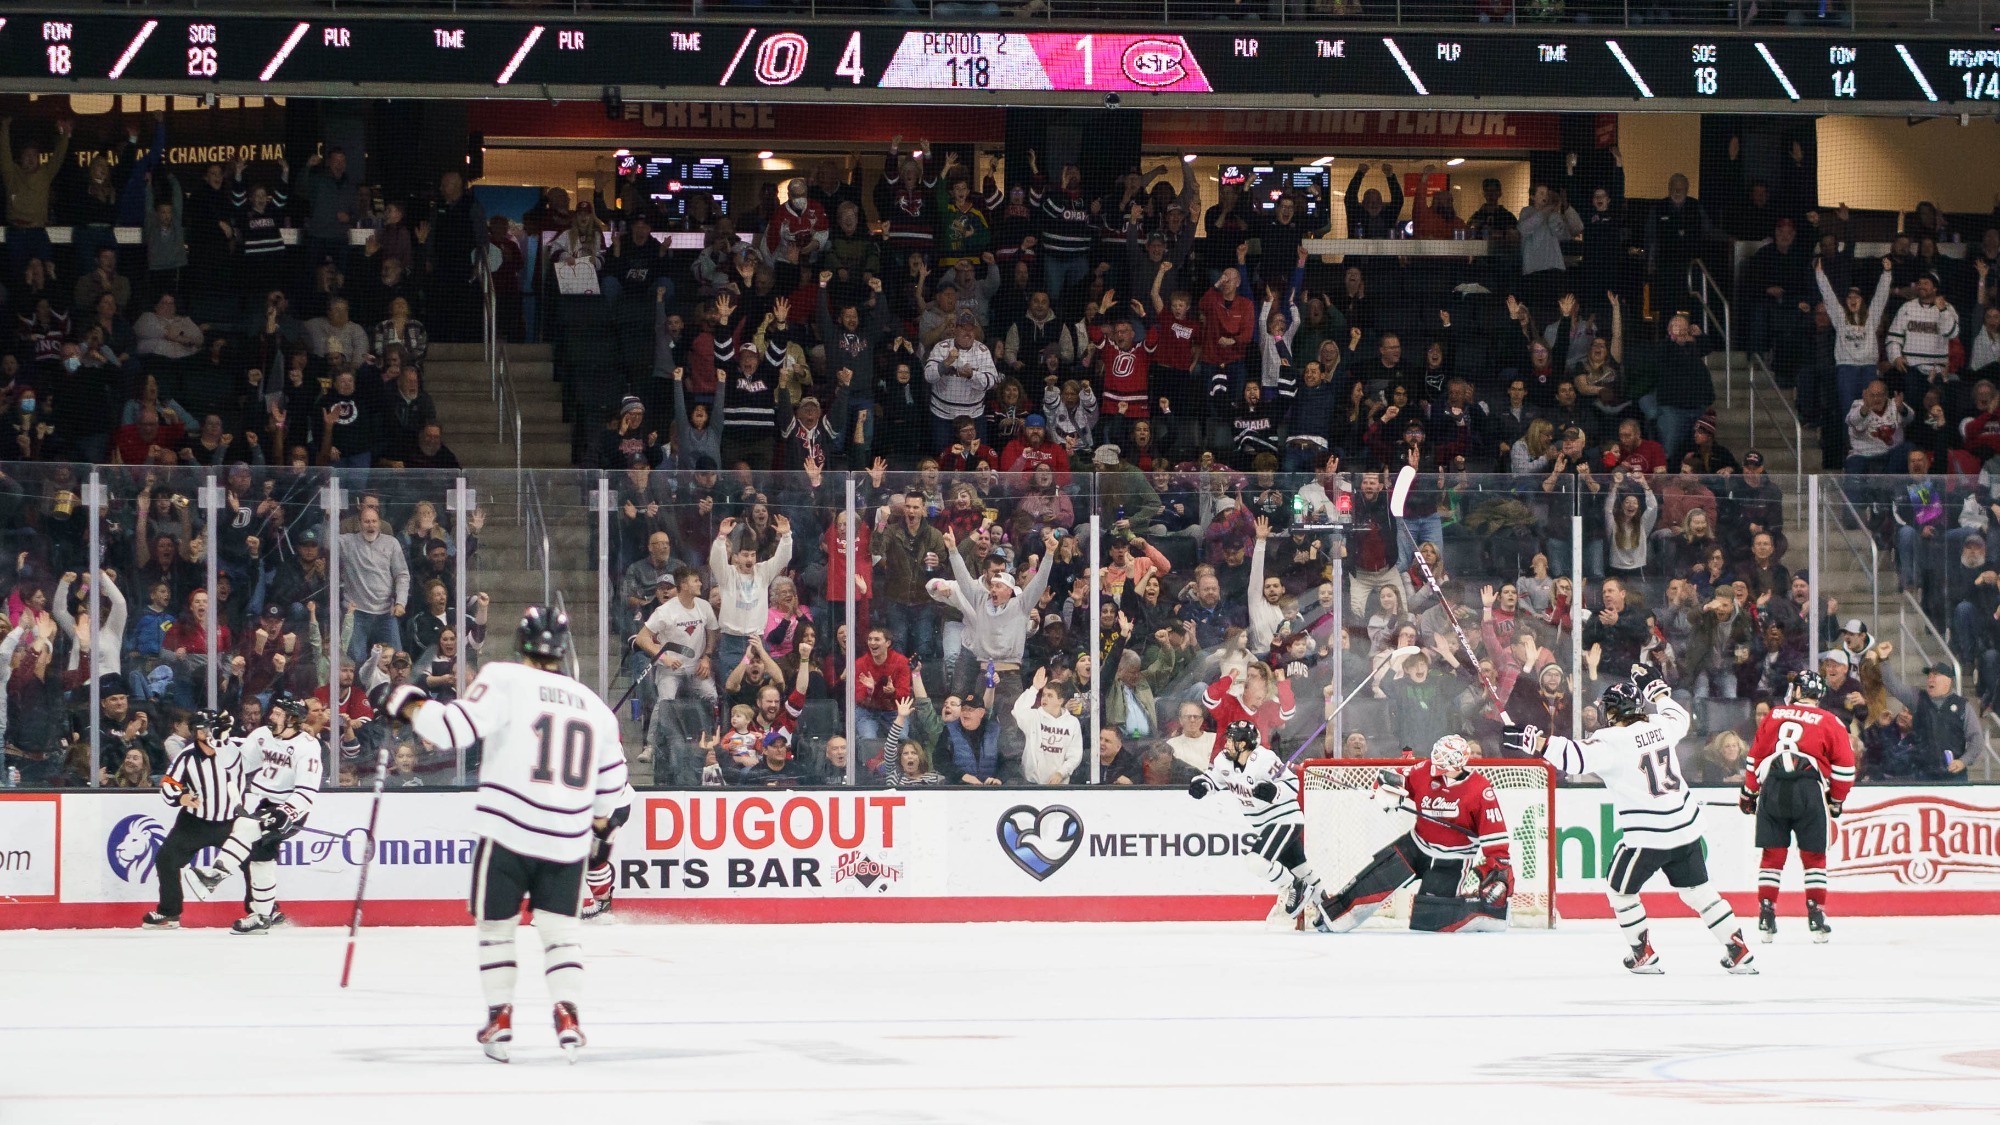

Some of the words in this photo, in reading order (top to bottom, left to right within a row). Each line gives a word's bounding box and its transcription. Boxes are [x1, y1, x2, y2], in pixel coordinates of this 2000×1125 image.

[43, 21, 73, 41] FOW
[188, 24, 217, 44] SOG
[324, 28, 351, 47] PLR
[433, 29, 466, 48] TIME
[558, 31, 585, 50] PLR
[670, 32, 702, 51] TIME
[923, 33, 982, 55] PERIOD
[997, 33, 1007, 55] 2
[1234, 38, 1259, 57] PLR
[1314, 39, 1346, 58] TIME
[1437, 43, 1462, 61] PLR
[1537, 44, 1568, 62] TIME
[46, 45, 72, 75] 18
[187, 47, 218, 77] 26
[835, 31, 866, 85] 4
[1075, 34, 1093, 85] 1
[946, 56, 990, 88] 1:18
[1693, 67, 1718, 95] 18
[1831, 70, 1857, 98] 14
[1962, 71, 2000, 100] 1/4
[170, 147, 235, 164] CHANGER
[240, 145, 256, 161] OF
[261, 144, 286, 160] MA
[1414, 551, 1441, 592] CCM
[1286, 660, 1309, 679] MAVS
[1771, 708, 1824, 725] SPELLACY
[1634, 728, 1666, 748] SLIPEC
[1775, 721, 1804, 753] 8
[530, 710, 594, 791] 10
[307, 758, 319, 774] 17
[1637, 745, 1682, 799] 13
[1431, 796, 1460, 811] Cloud
[646, 797, 906, 850] DUGOUT
[310, 836, 342, 863] of
[728, 858, 823, 888] BAR
[835, 861, 900, 884] DUGOUT
